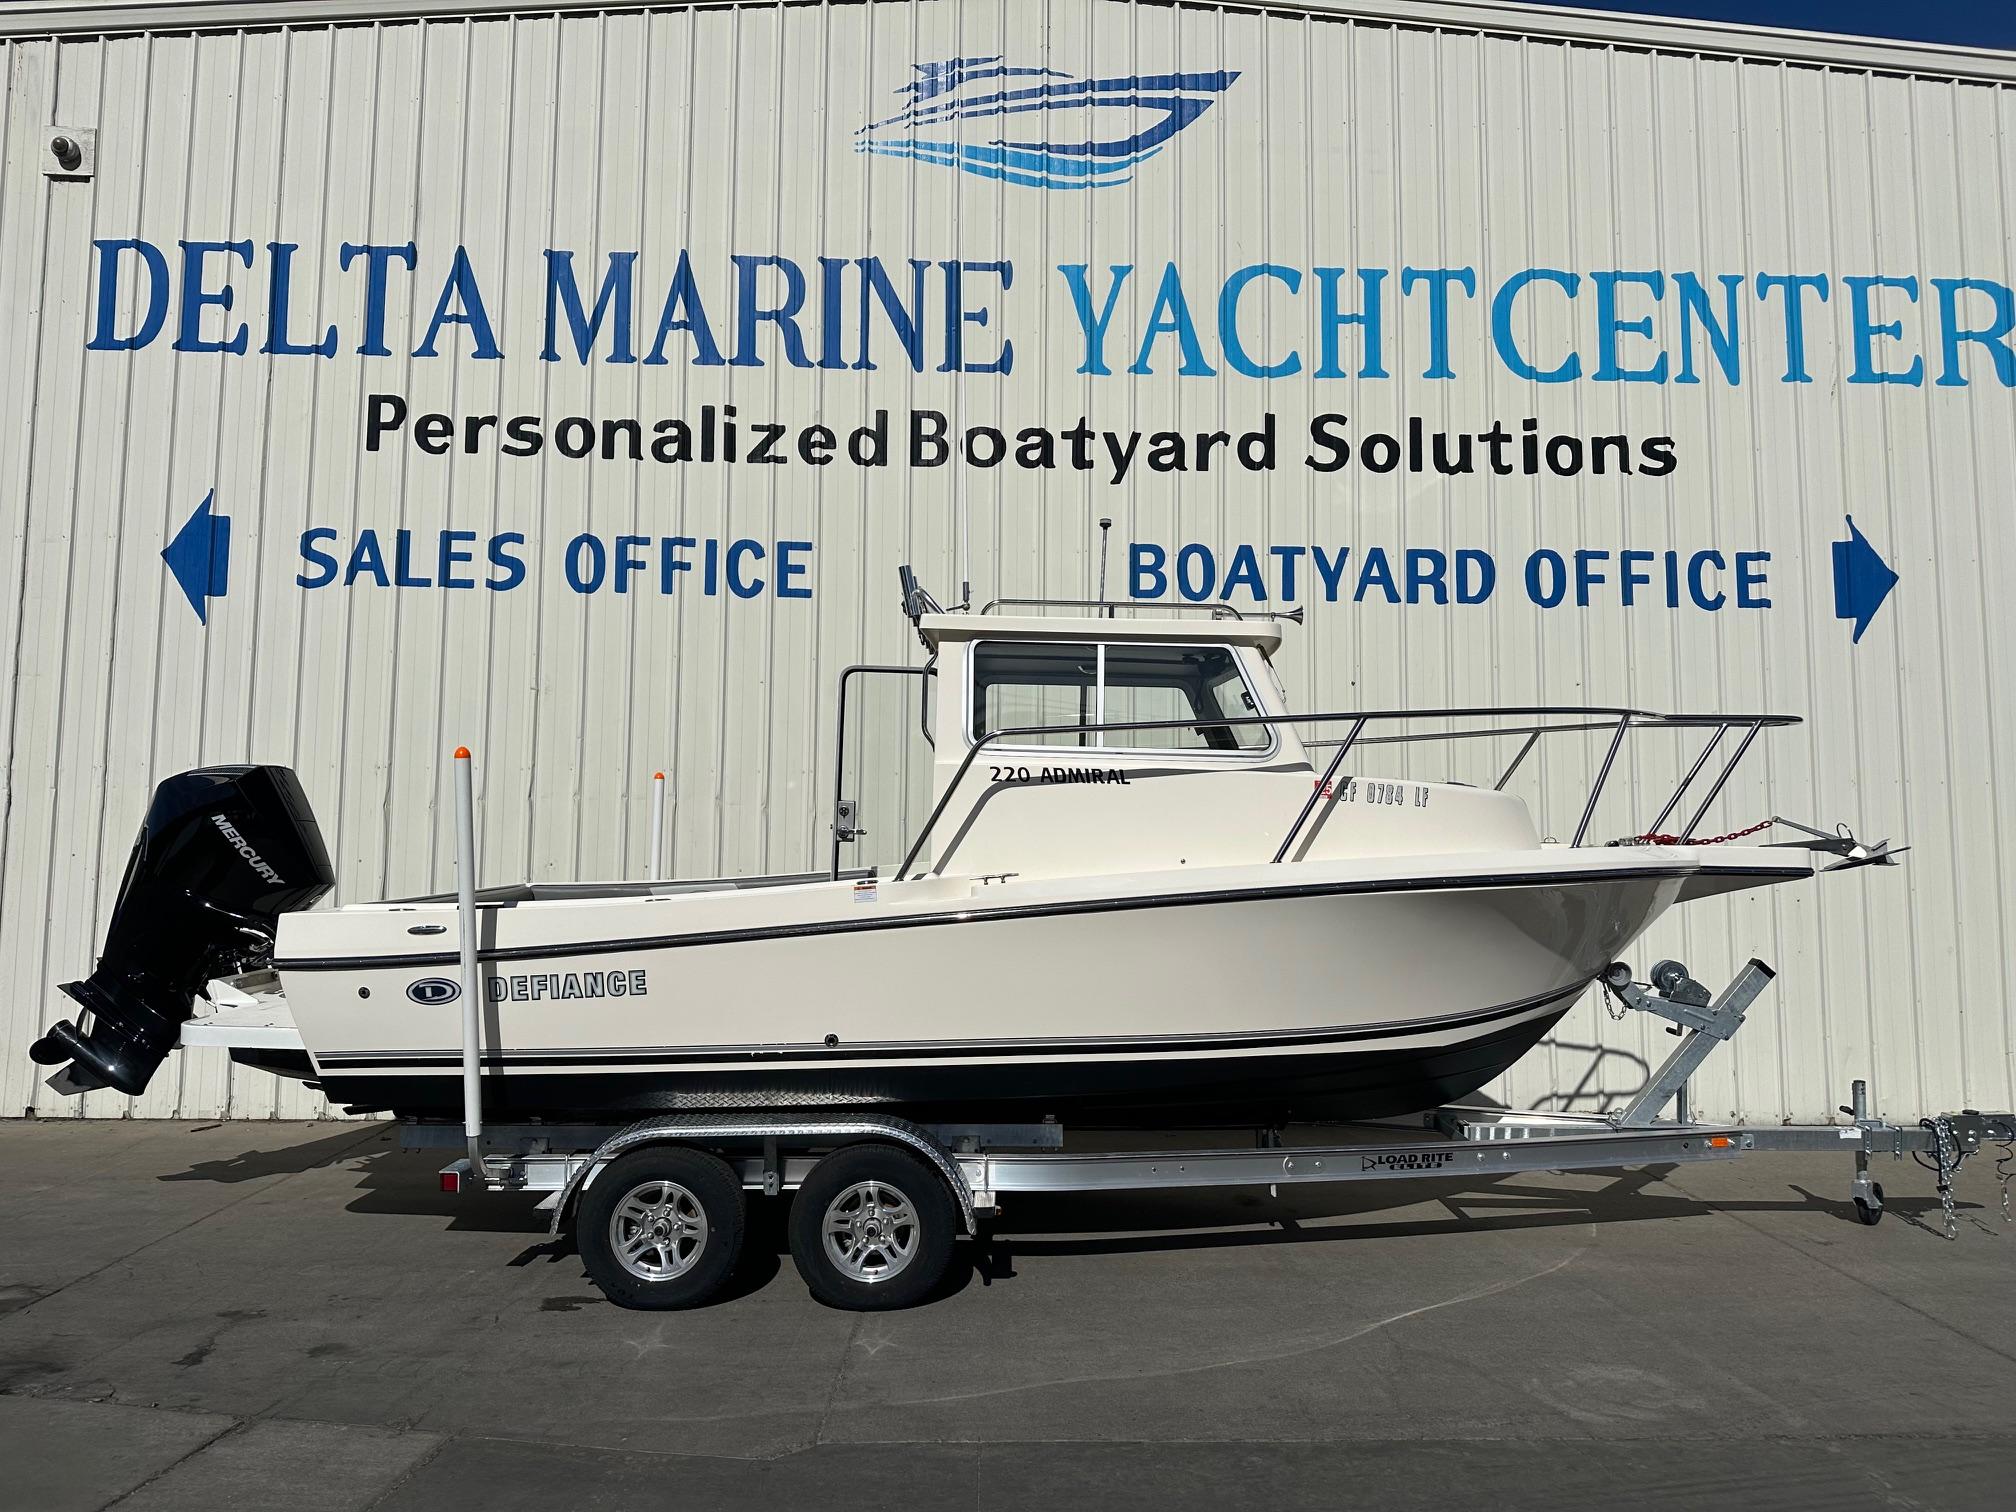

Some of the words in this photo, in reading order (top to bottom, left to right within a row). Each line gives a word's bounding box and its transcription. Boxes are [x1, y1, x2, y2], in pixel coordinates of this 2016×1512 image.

[86, 239, 504, 359] DELTA
[539, 249, 1013, 375] MARINE
[366, 394, 888, 468] Personalized
[909, 409, 1276, 485] Boatyard
[1304, 413, 1678, 477] Solutions
[296, 527, 526, 592] SALES
[565, 533, 813, 600] OFFICE
[1129, 543, 1496, 605] BOATYARD
[1524, 549, 1772, 612] OFFICE
[990, 766, 1030, 782] 220
[1040, 767, 1131, 784] ADMIRAL
[1340, 781, 1357, 802] CF
[1366, 782, 1403, 805] 0784
[1414, 786, 1428, 807] LF
[211, 814, 285, 884] MERCURY
[488, 969, 647, 1002] DEFIANCE
[1377, 1154, 1418, 1164] LOAD
[1421, 1152, 1454, 1162] RITE
